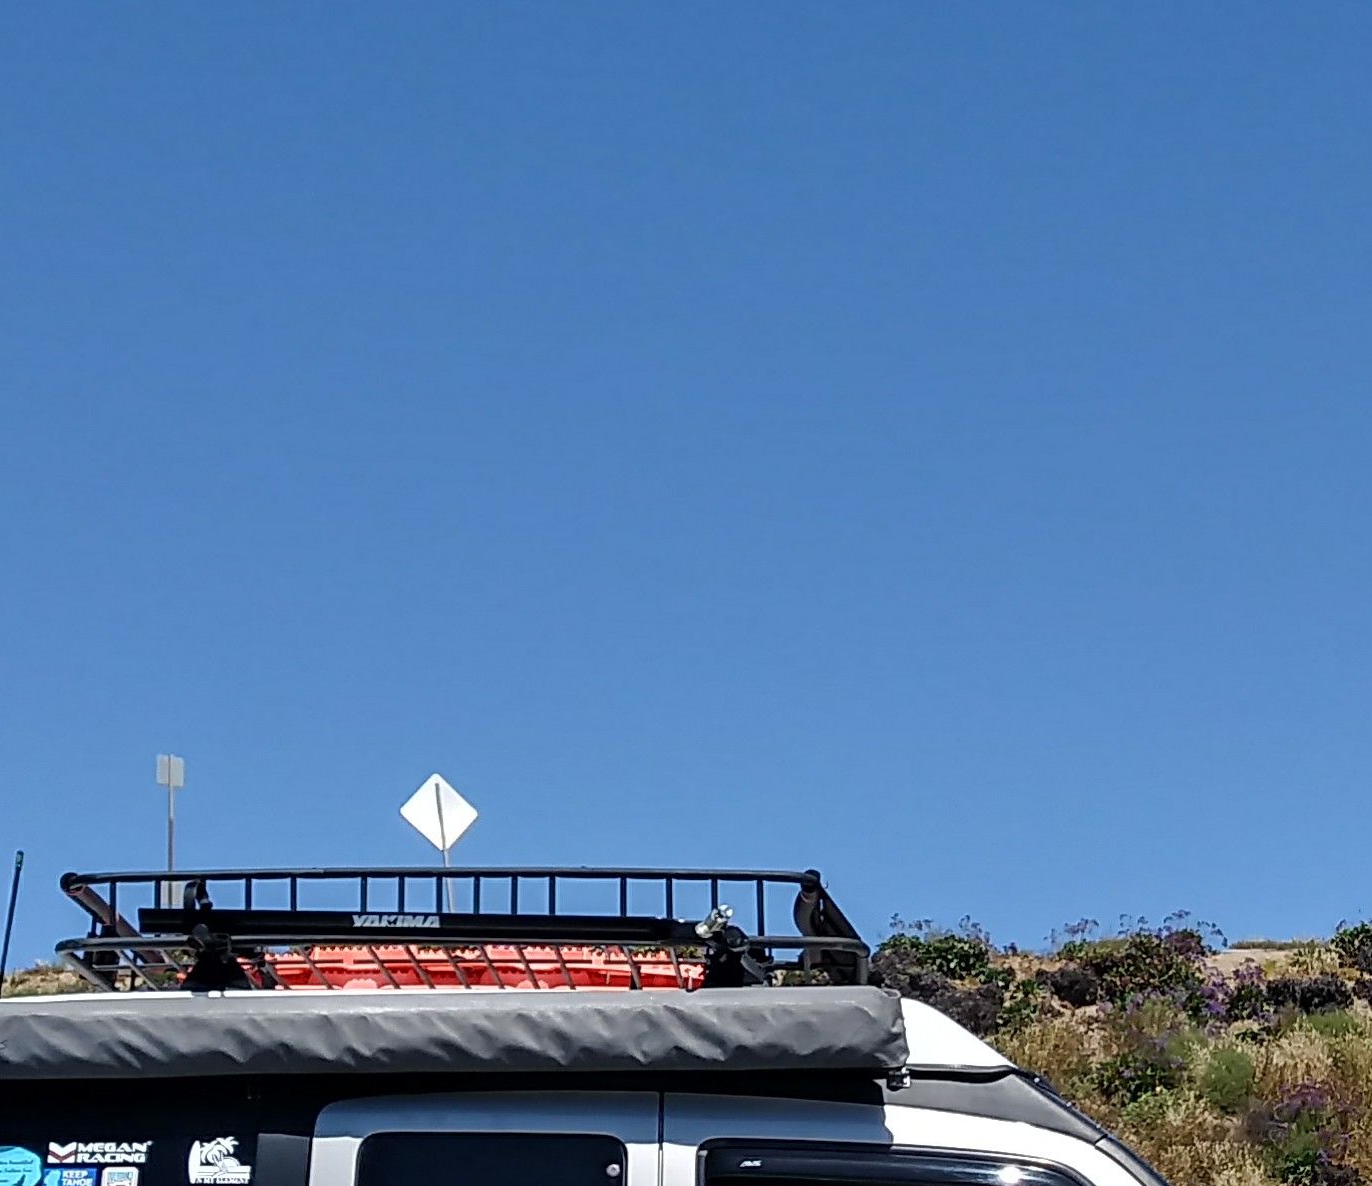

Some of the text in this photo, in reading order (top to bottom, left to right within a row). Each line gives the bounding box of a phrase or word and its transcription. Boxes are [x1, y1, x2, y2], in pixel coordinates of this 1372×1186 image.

[351, 914, 441, 928] YAKIMA
[77, 1142, 147, 1152] MEGAN
[76, 1153, 146, 1163] RACING
[62, 1170, 88, 1178] KEEP
[61, 1178, 93, 1186] TAHOE
